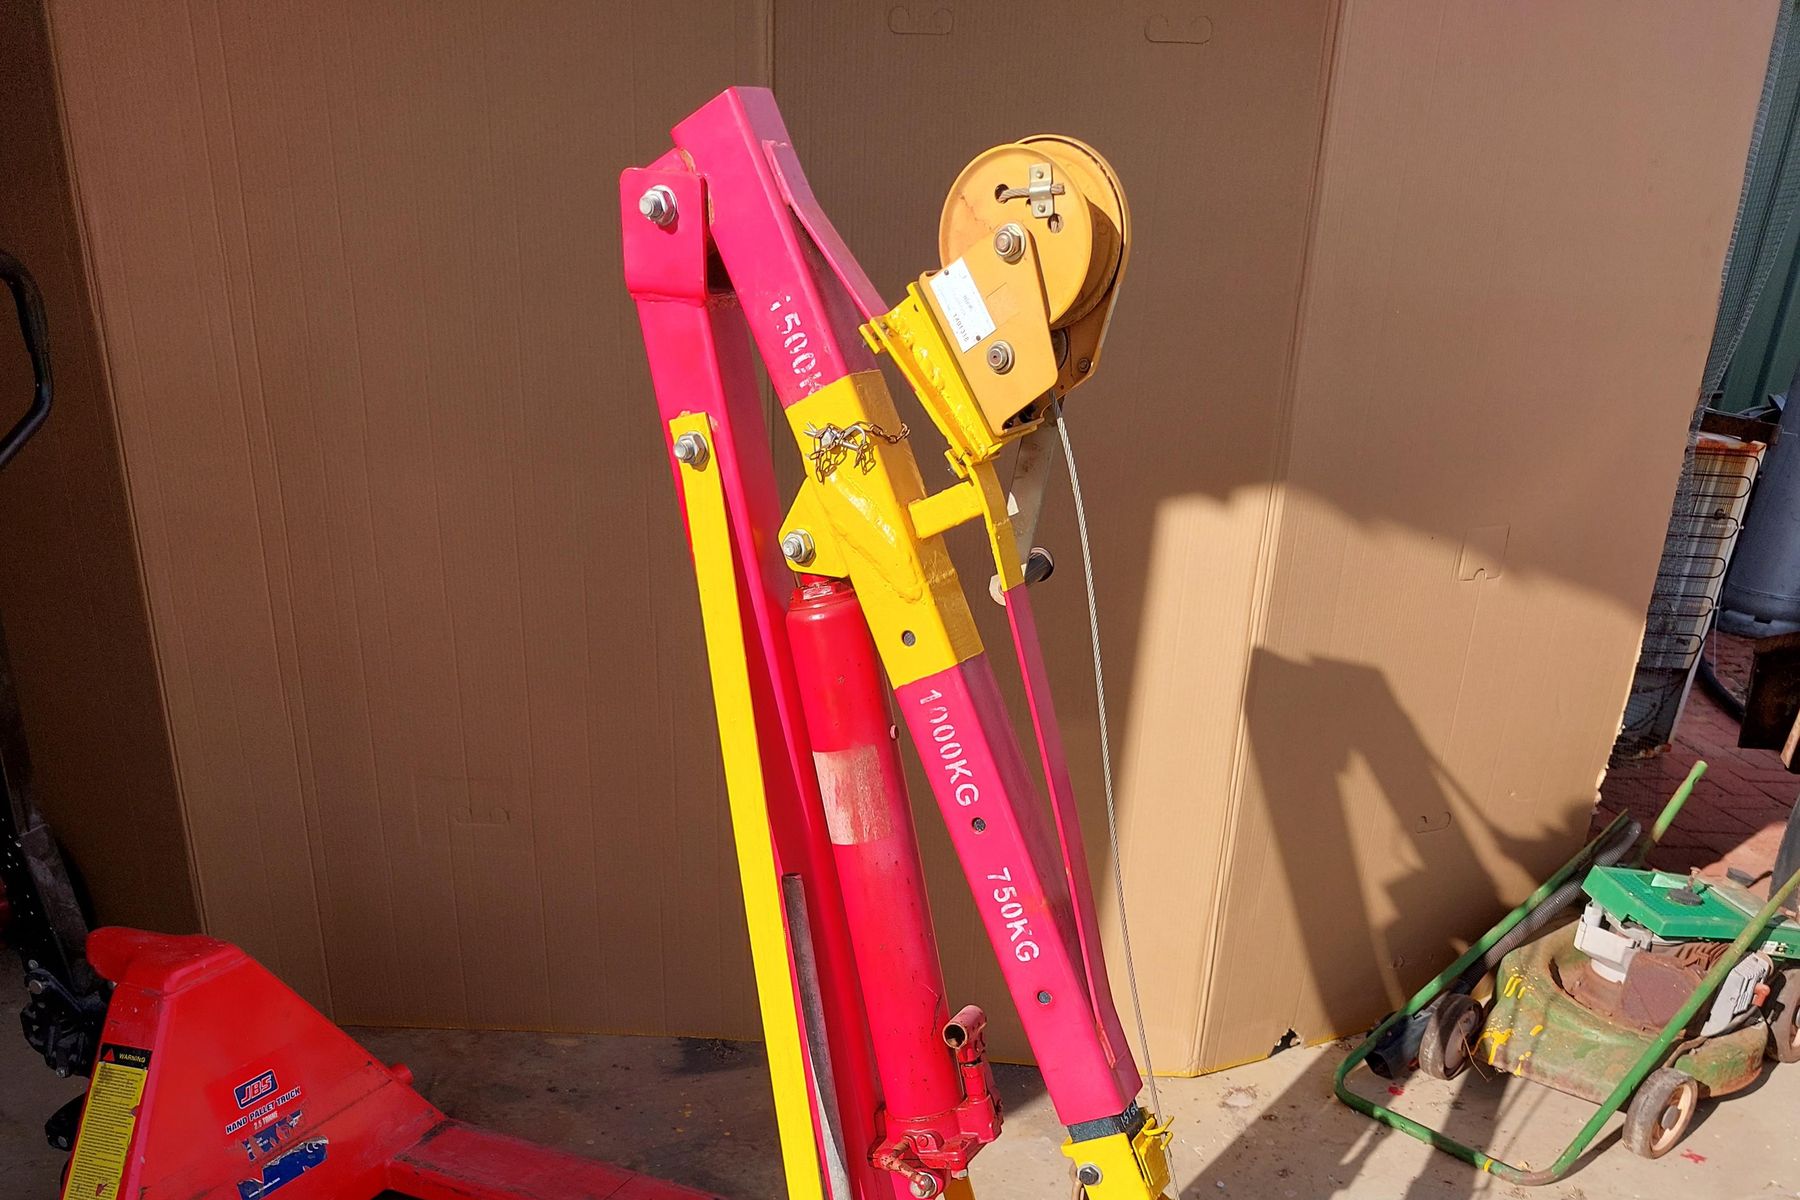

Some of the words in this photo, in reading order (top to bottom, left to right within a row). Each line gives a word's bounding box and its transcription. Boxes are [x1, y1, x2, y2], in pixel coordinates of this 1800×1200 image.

[919, 689, 980, 807] 1000KG
[977, 866, 1040, 963] 750KG
[119, 1053, 146, 1064] WARNING
[225, 1116, 249, 1135] HAND
[248, 1100, 276, 1122] PALLET
[275, 1086, 302, 1107] TRUCK
[240, 1074, 273, 1105] JBS
